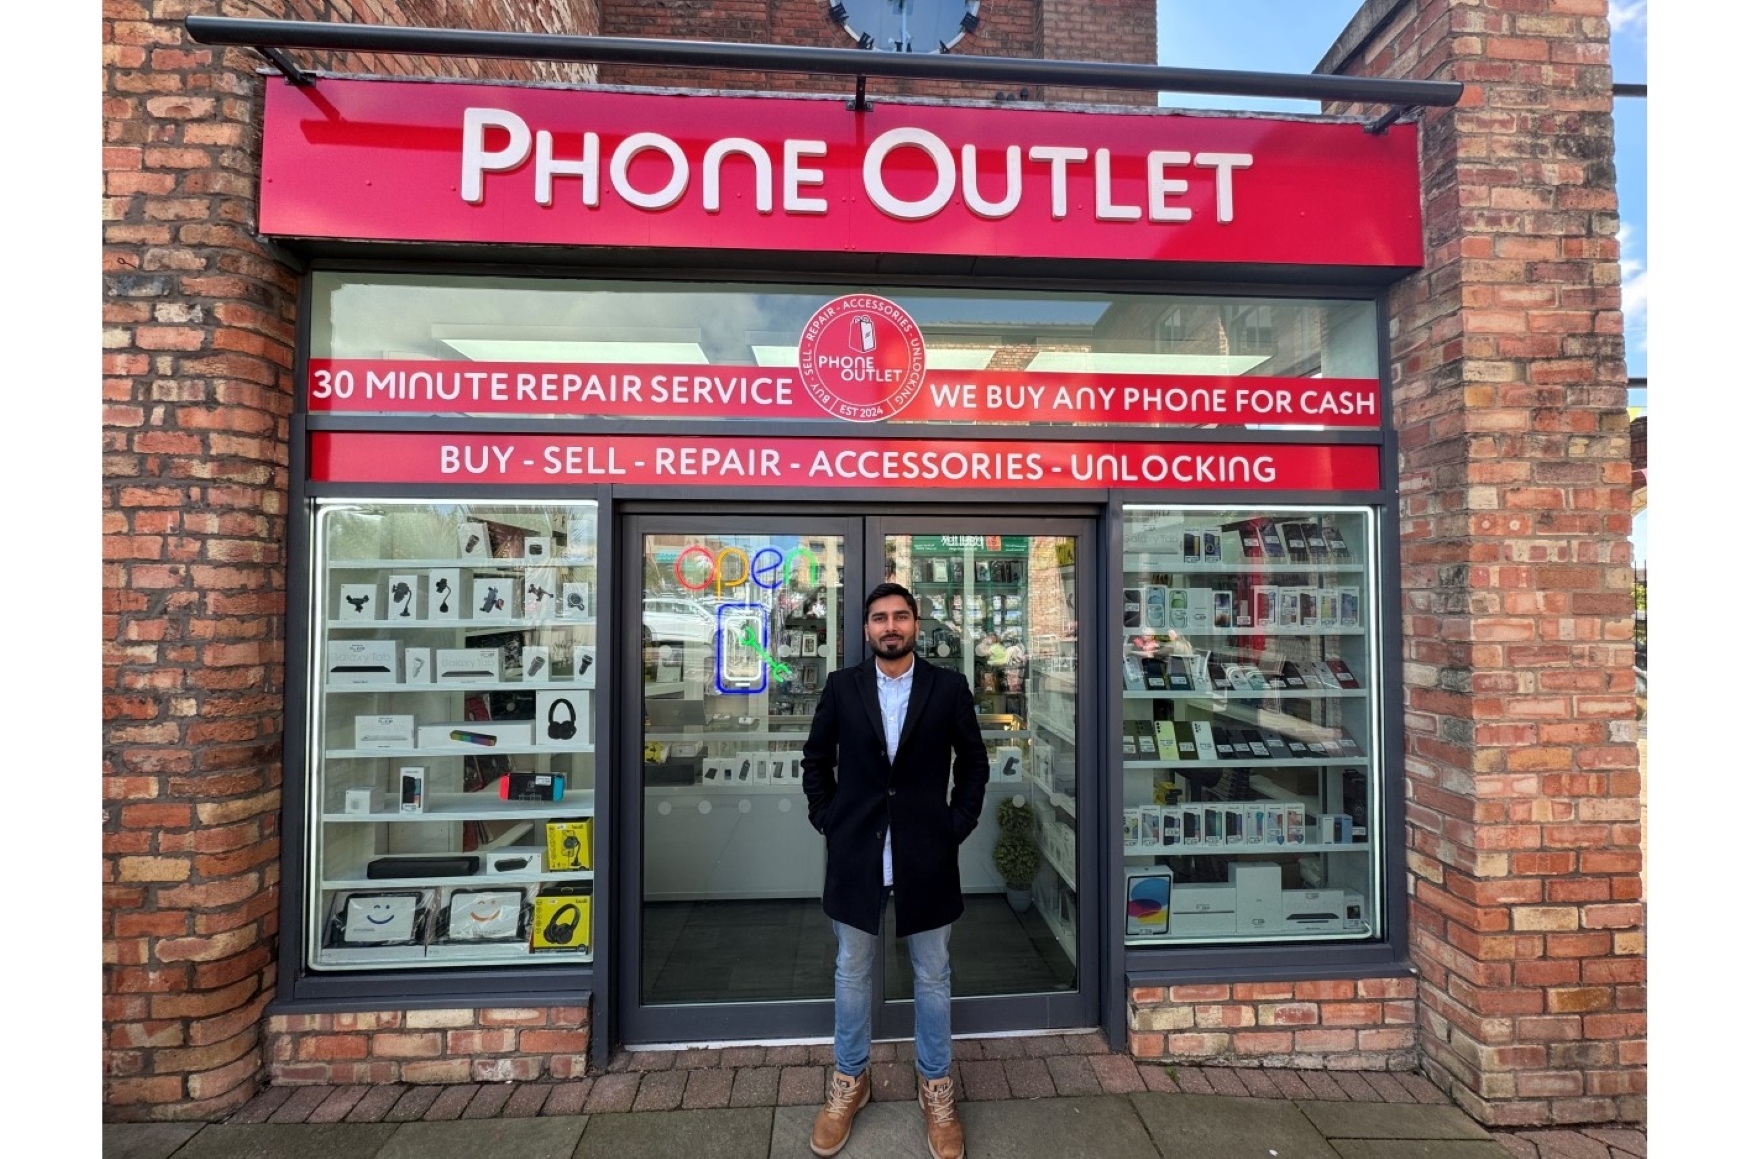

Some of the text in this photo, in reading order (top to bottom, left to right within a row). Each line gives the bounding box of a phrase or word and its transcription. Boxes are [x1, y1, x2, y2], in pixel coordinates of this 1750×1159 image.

[461, 107, 1253, 224] PHONE OUTLET
[803, 299, 922, 405] BUY SELL REPAIR ACCESSORIES UNLOCKING
[818, 355, 875, 369] PHONE
[313, 369, 793, 405] 30 MINUTE REPAIR SERVICE
[841, 368, 903, 382] OUTLET
[840, 404, 883, 417] EST 2024
[930, 383, 1375, 415] WE BUY ANY PHONE FOR CASH
[441, 445, 514, 474] BUY
[543, 445, 626, 475] SELL
[655, 447, 782, 476] REPAIR
[808, 450, 1043, 480] ACCESSORIES
[1071, 454, 1276, 483] UNLOCKING
[674, 544, 818, 601] open
